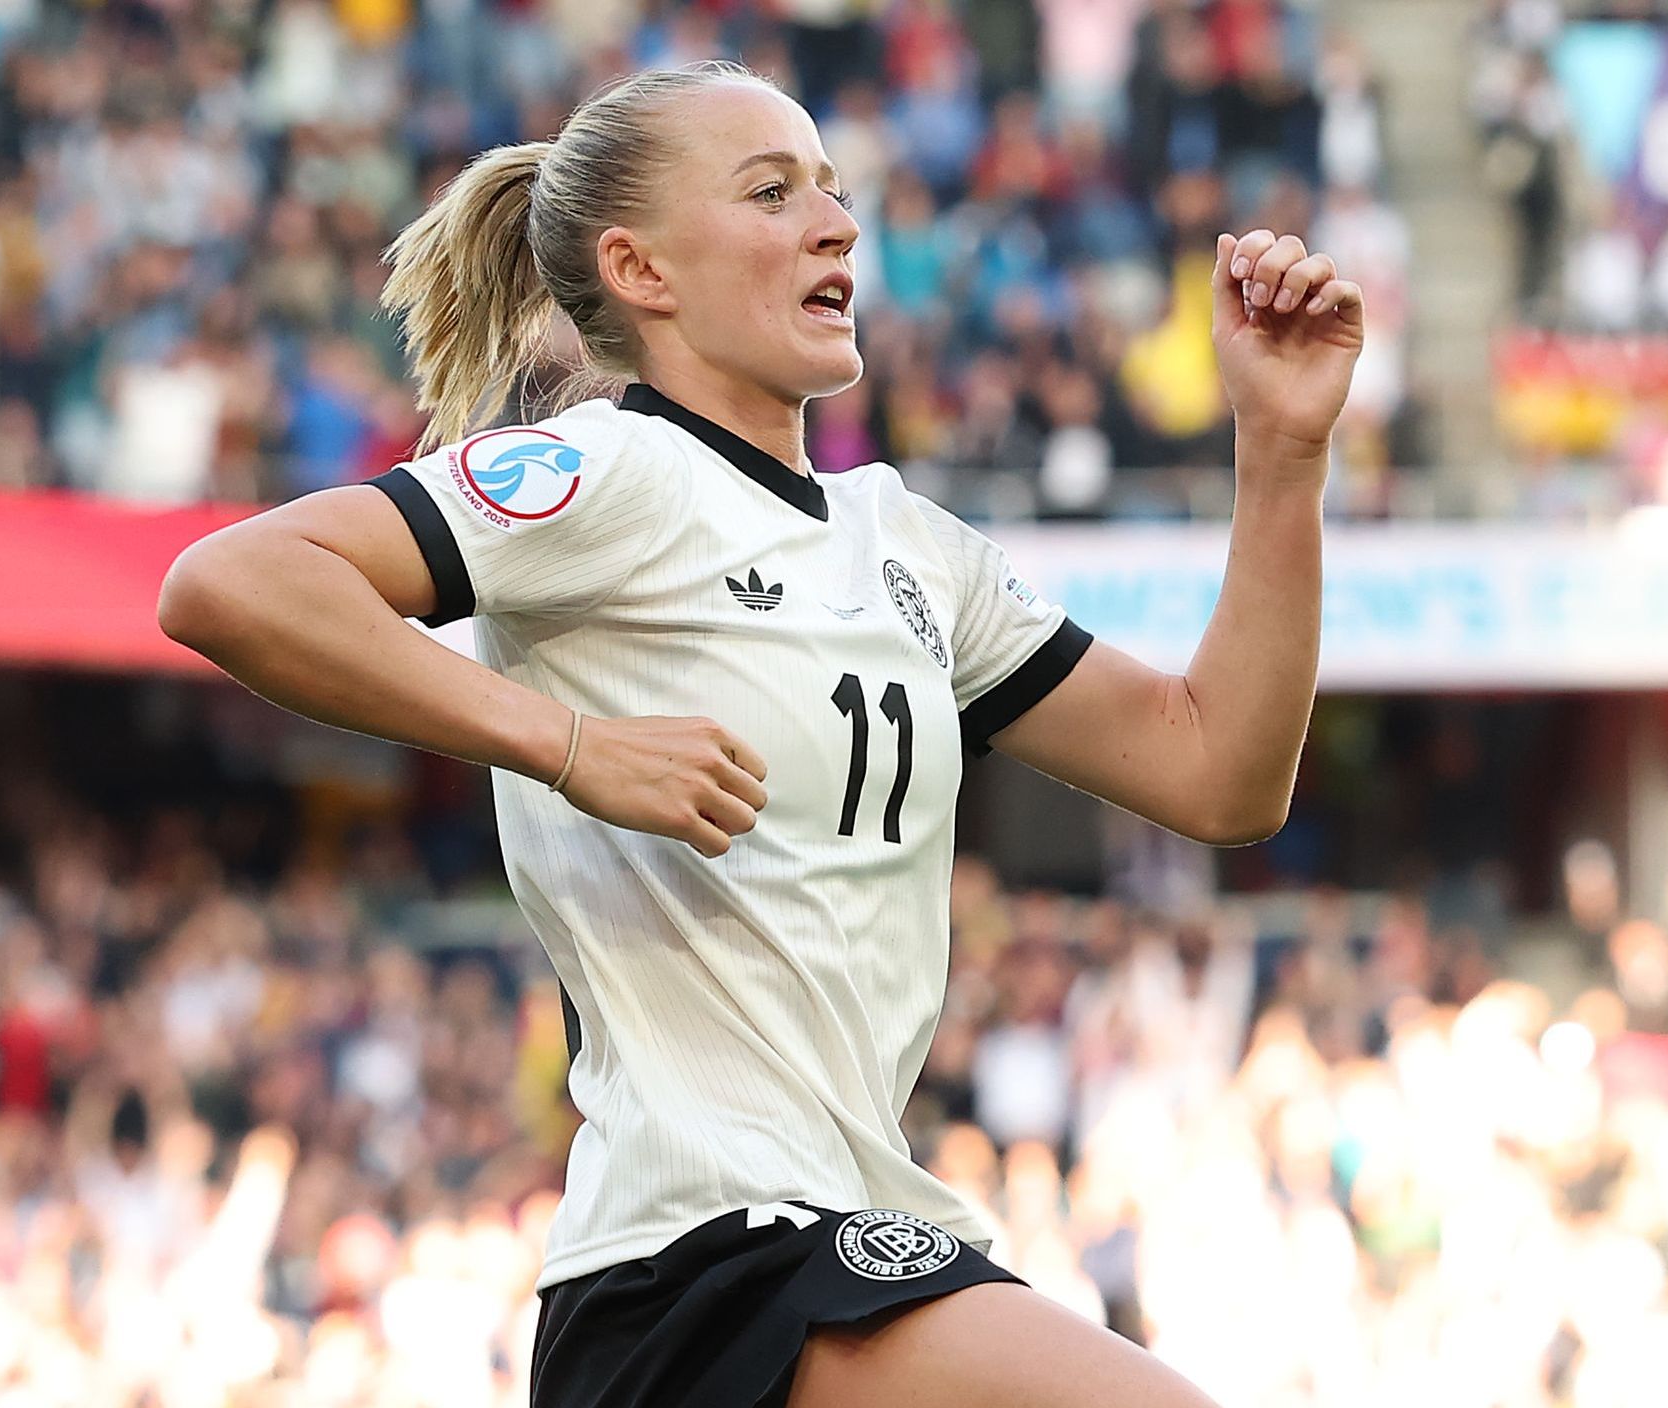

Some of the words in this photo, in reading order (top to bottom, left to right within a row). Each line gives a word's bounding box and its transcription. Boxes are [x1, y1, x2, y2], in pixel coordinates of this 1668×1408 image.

[448, 451, 483, 510] SWITZERLAND
[483, 509, 511, 528] 2025
[1060, 565, 1492, 640] WON'S
[830, 672, 914, 845] 11
[842, 1225, 904, 1276] DEUTSCHER
